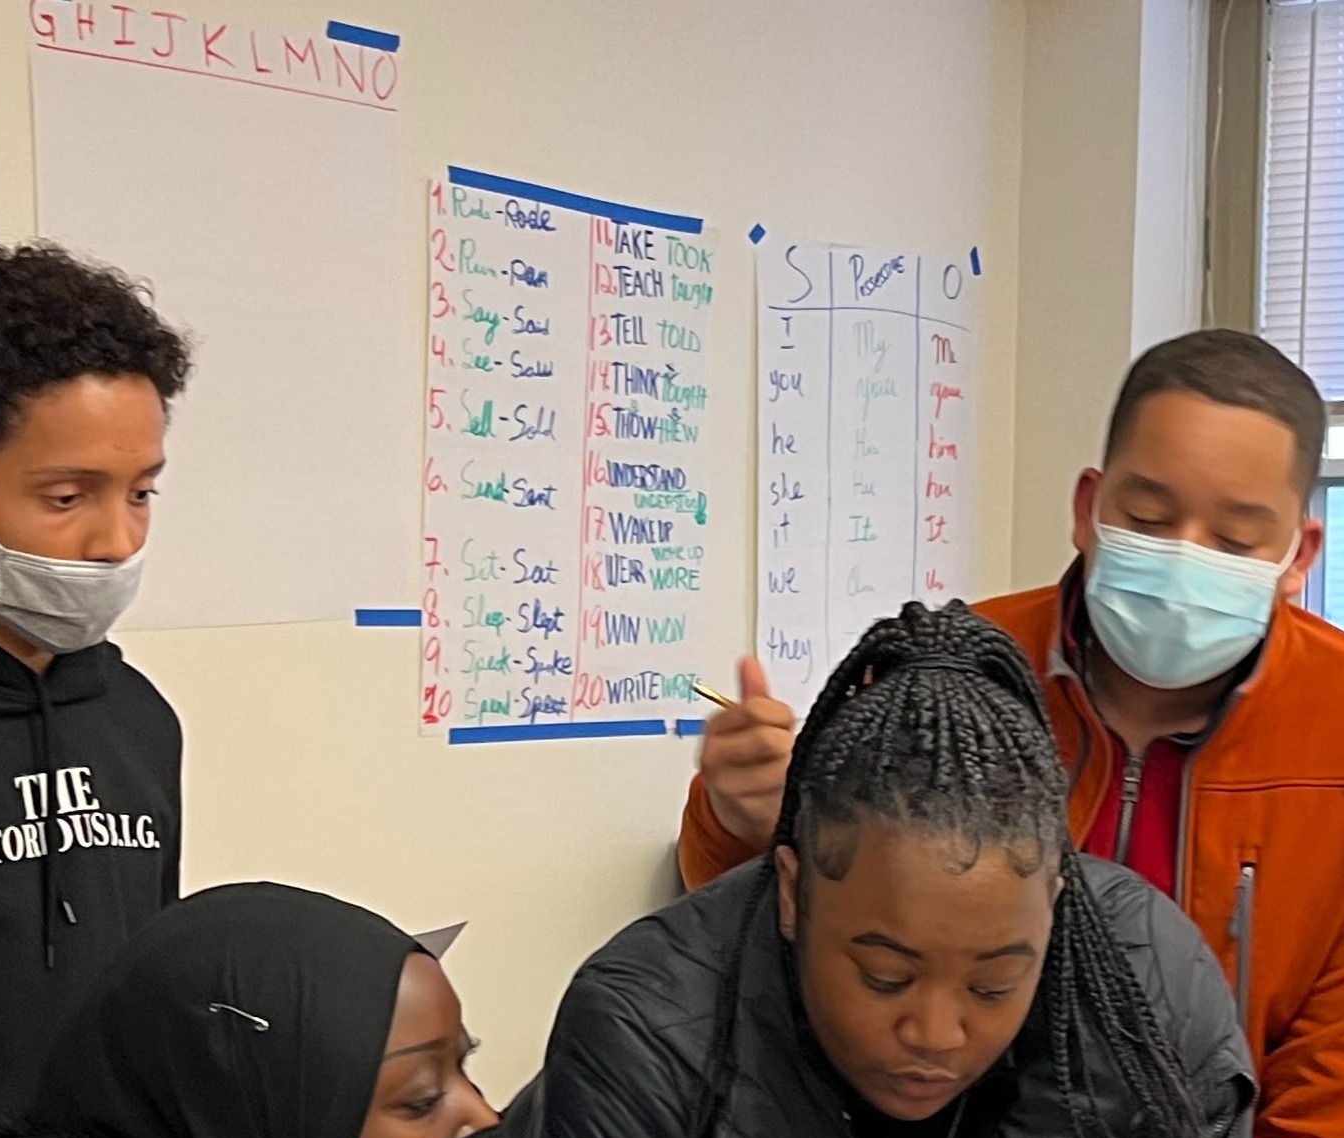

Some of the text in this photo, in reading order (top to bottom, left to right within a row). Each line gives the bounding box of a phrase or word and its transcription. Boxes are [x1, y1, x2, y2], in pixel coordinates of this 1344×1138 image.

[29, 0, 398, 100] G H I J K L M N O
[611, 219, 656, 261] TAKE
[612, 265, 664, 298] TEACH
[785, 245, 813, 304] S
[768, 369, 804, 403] you
[772, 423, 797, 454] he
[770, 472, 805, 507] she
[649, 566, 700, 591] WORE
[604, 610, 641, 646] WIN
[767, 626, 813, 684] they
[606, 670, 661, 704] WRITE
[13, 767, 100, 820] THE
